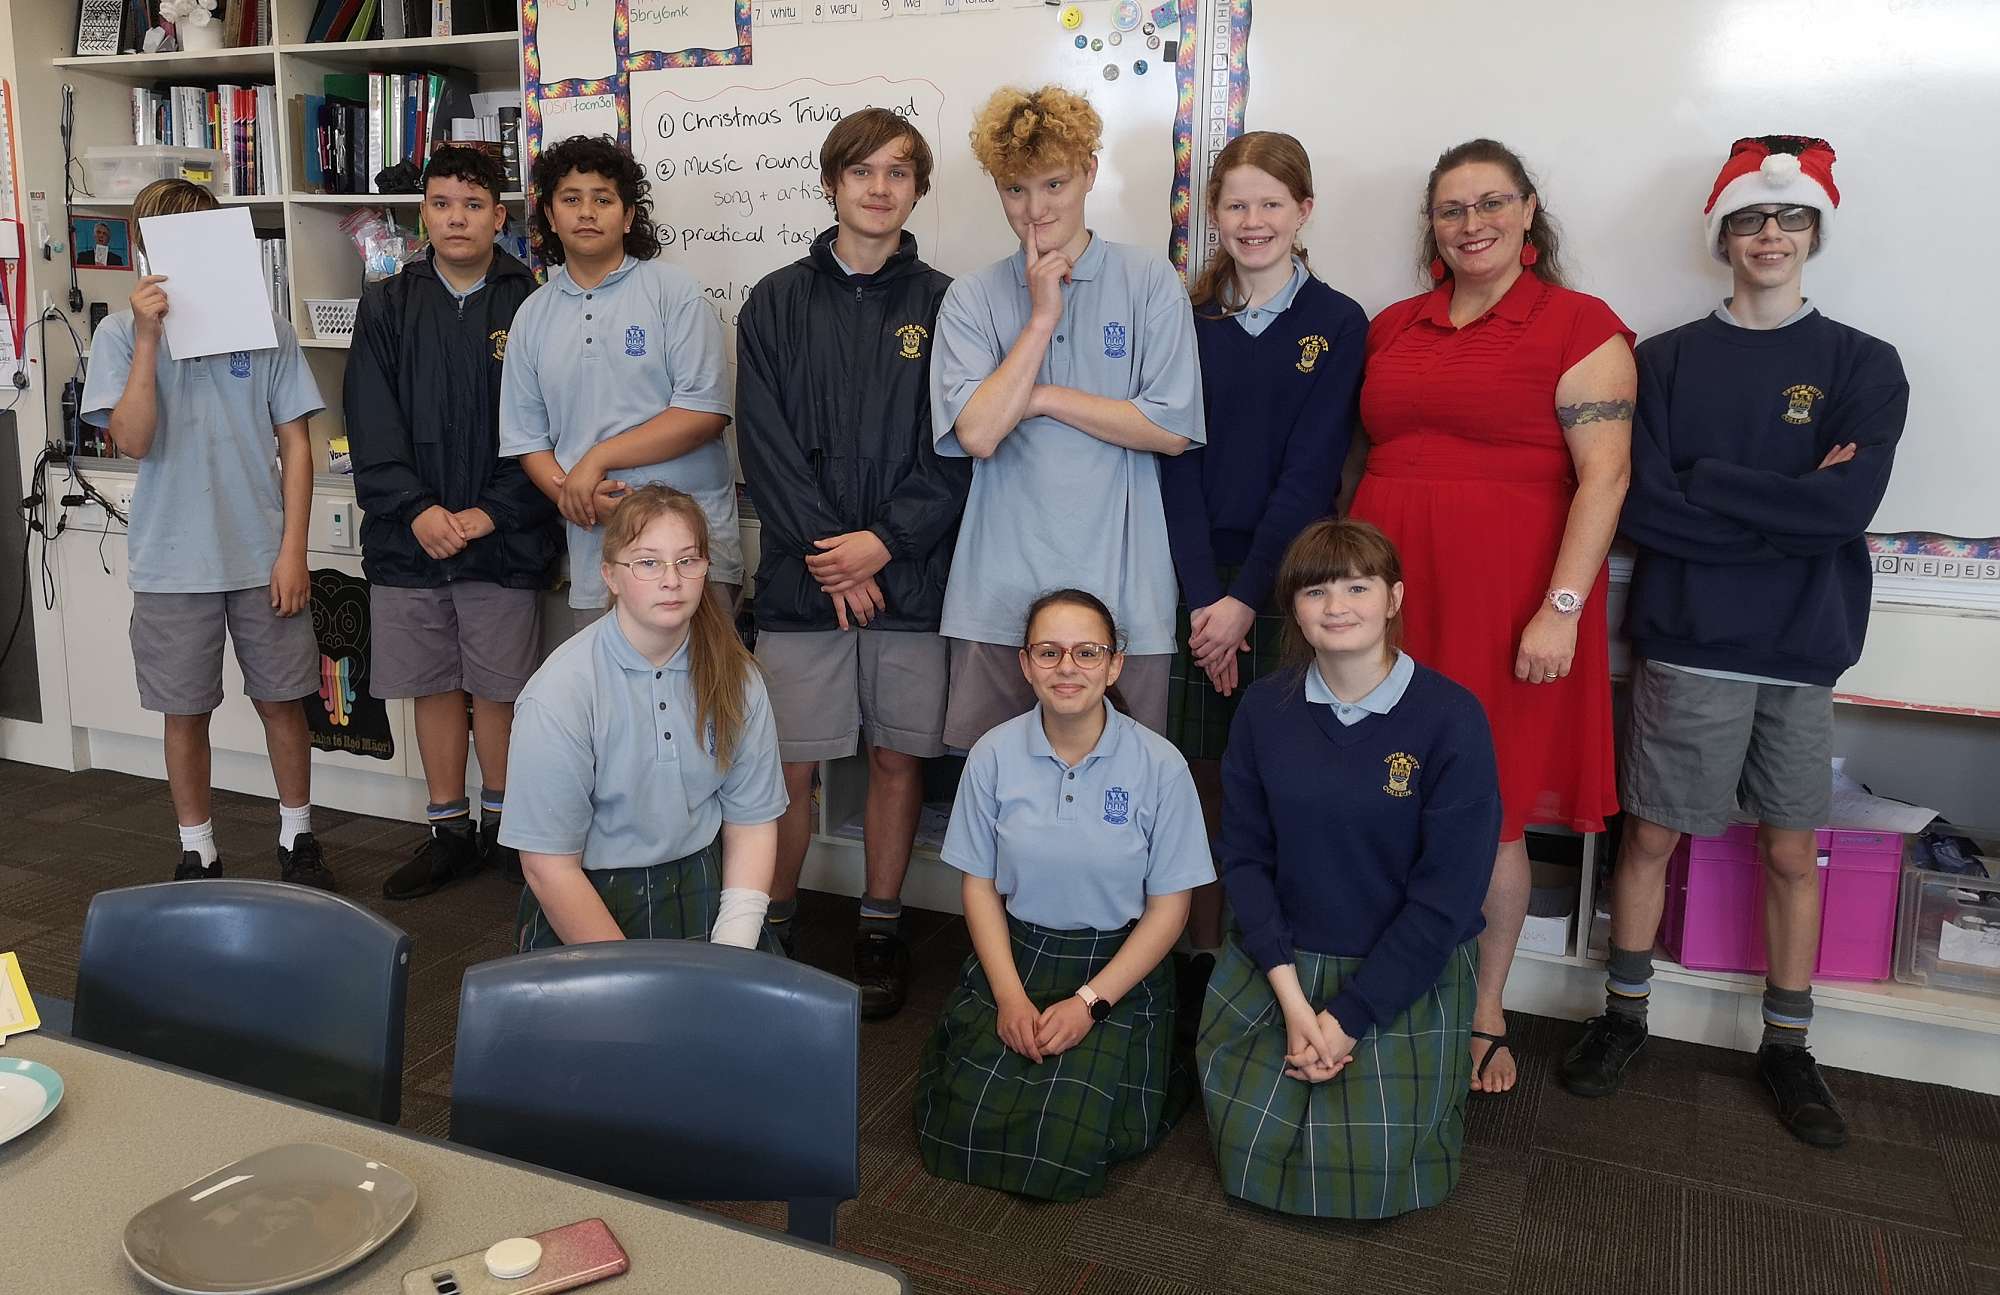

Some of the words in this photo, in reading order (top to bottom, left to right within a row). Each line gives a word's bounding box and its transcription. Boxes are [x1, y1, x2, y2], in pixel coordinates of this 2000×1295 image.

[755, 8, 760, 21] 7
[770, 6, 796, 19] whitu
[815, 4, 822, 16] 8
[830, 3, 857, 15] waru
[683, 106, 782, 132] Christmas
[788, 97, 843, 124] Trivia
[684, 153, 743, 177] Music
[756, 150, 819, 171] round
[714, 190, 754, 218] song
[777, 180, 824, 201] artis
[681, 223, 765, 251] practical
